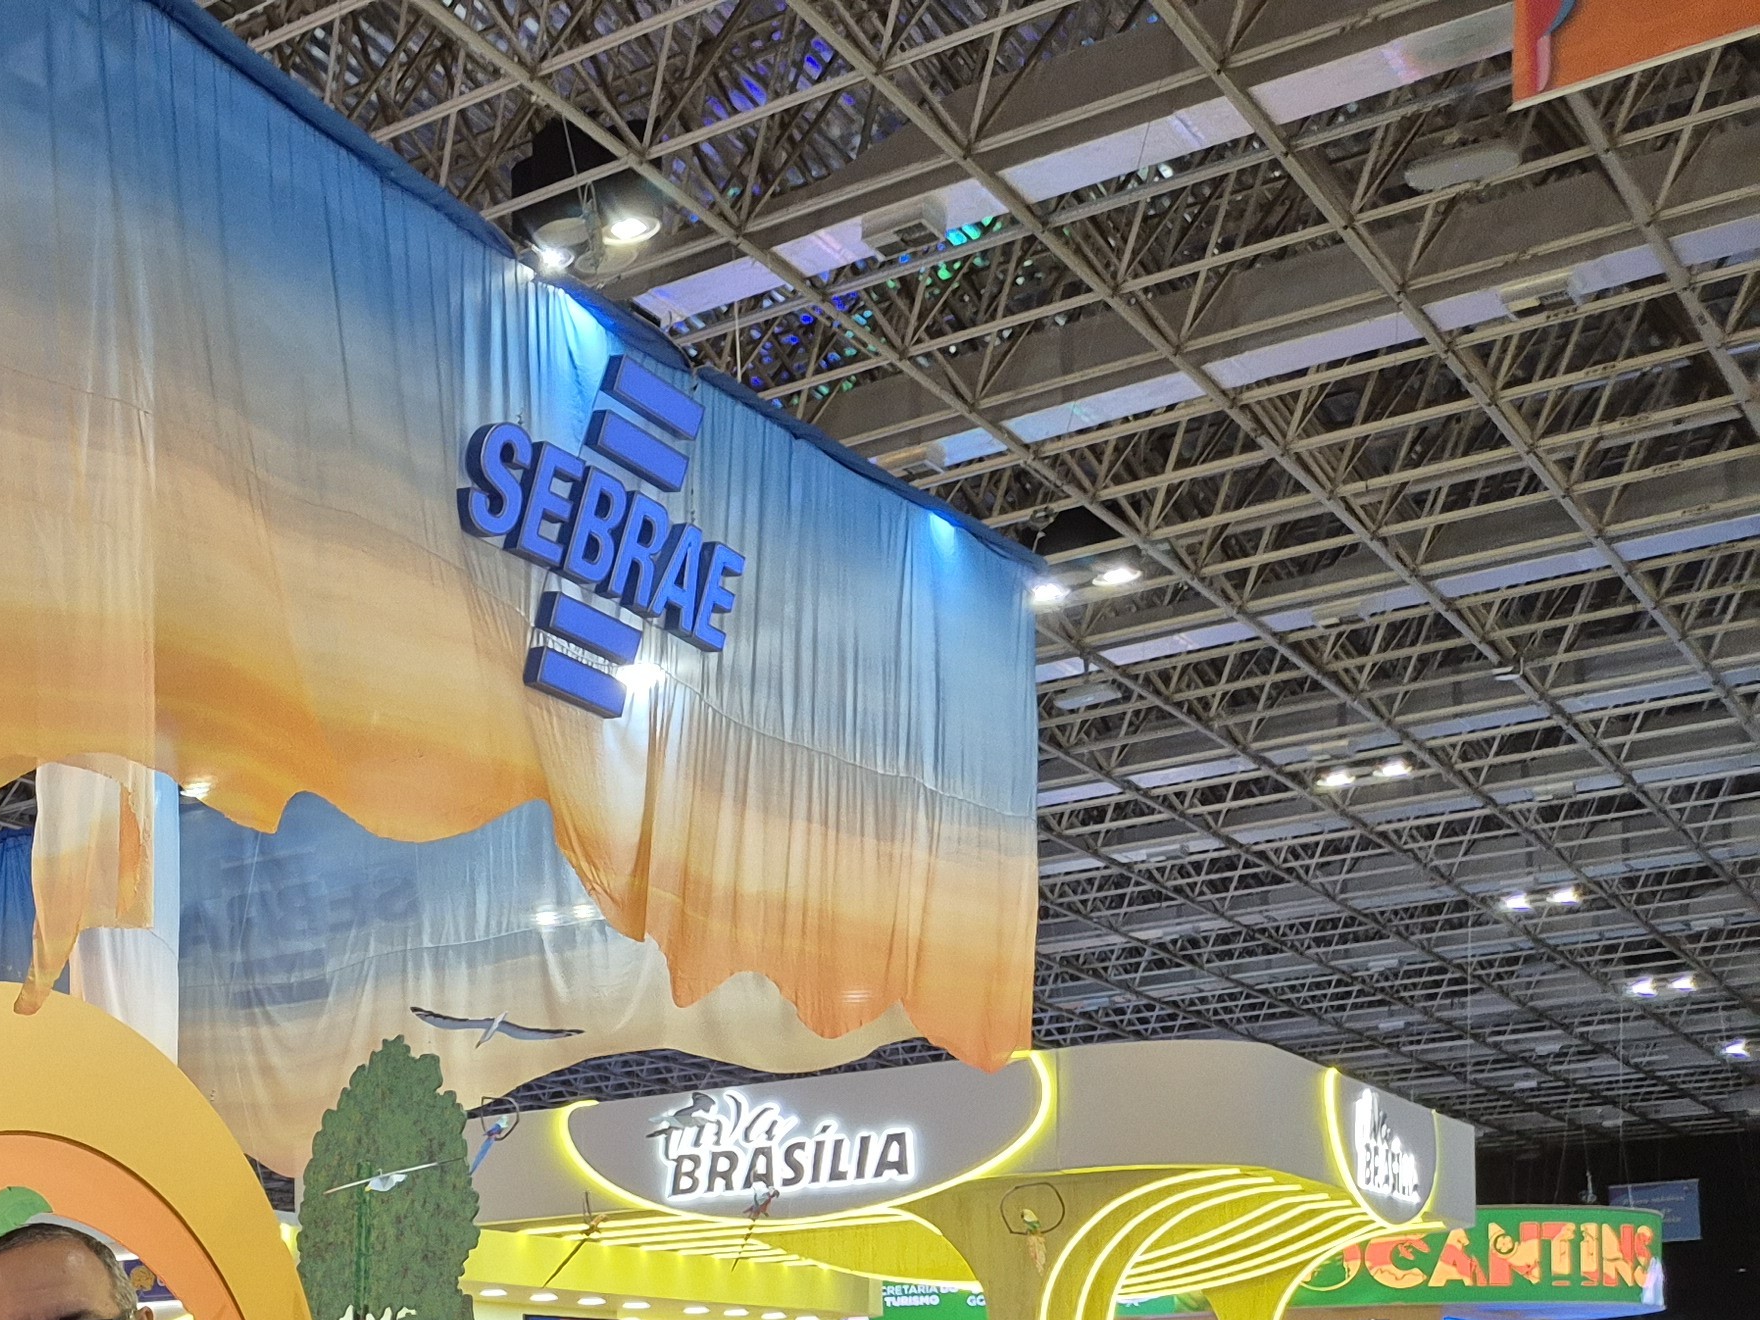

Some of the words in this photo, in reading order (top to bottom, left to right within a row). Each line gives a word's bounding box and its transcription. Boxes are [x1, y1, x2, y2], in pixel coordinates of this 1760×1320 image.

[457, 422, 746, 653] SEBRAE
[669, 1124, 910, 1197] BRASÍLIA
[885, 1295, 940, 1307] TURISMO
